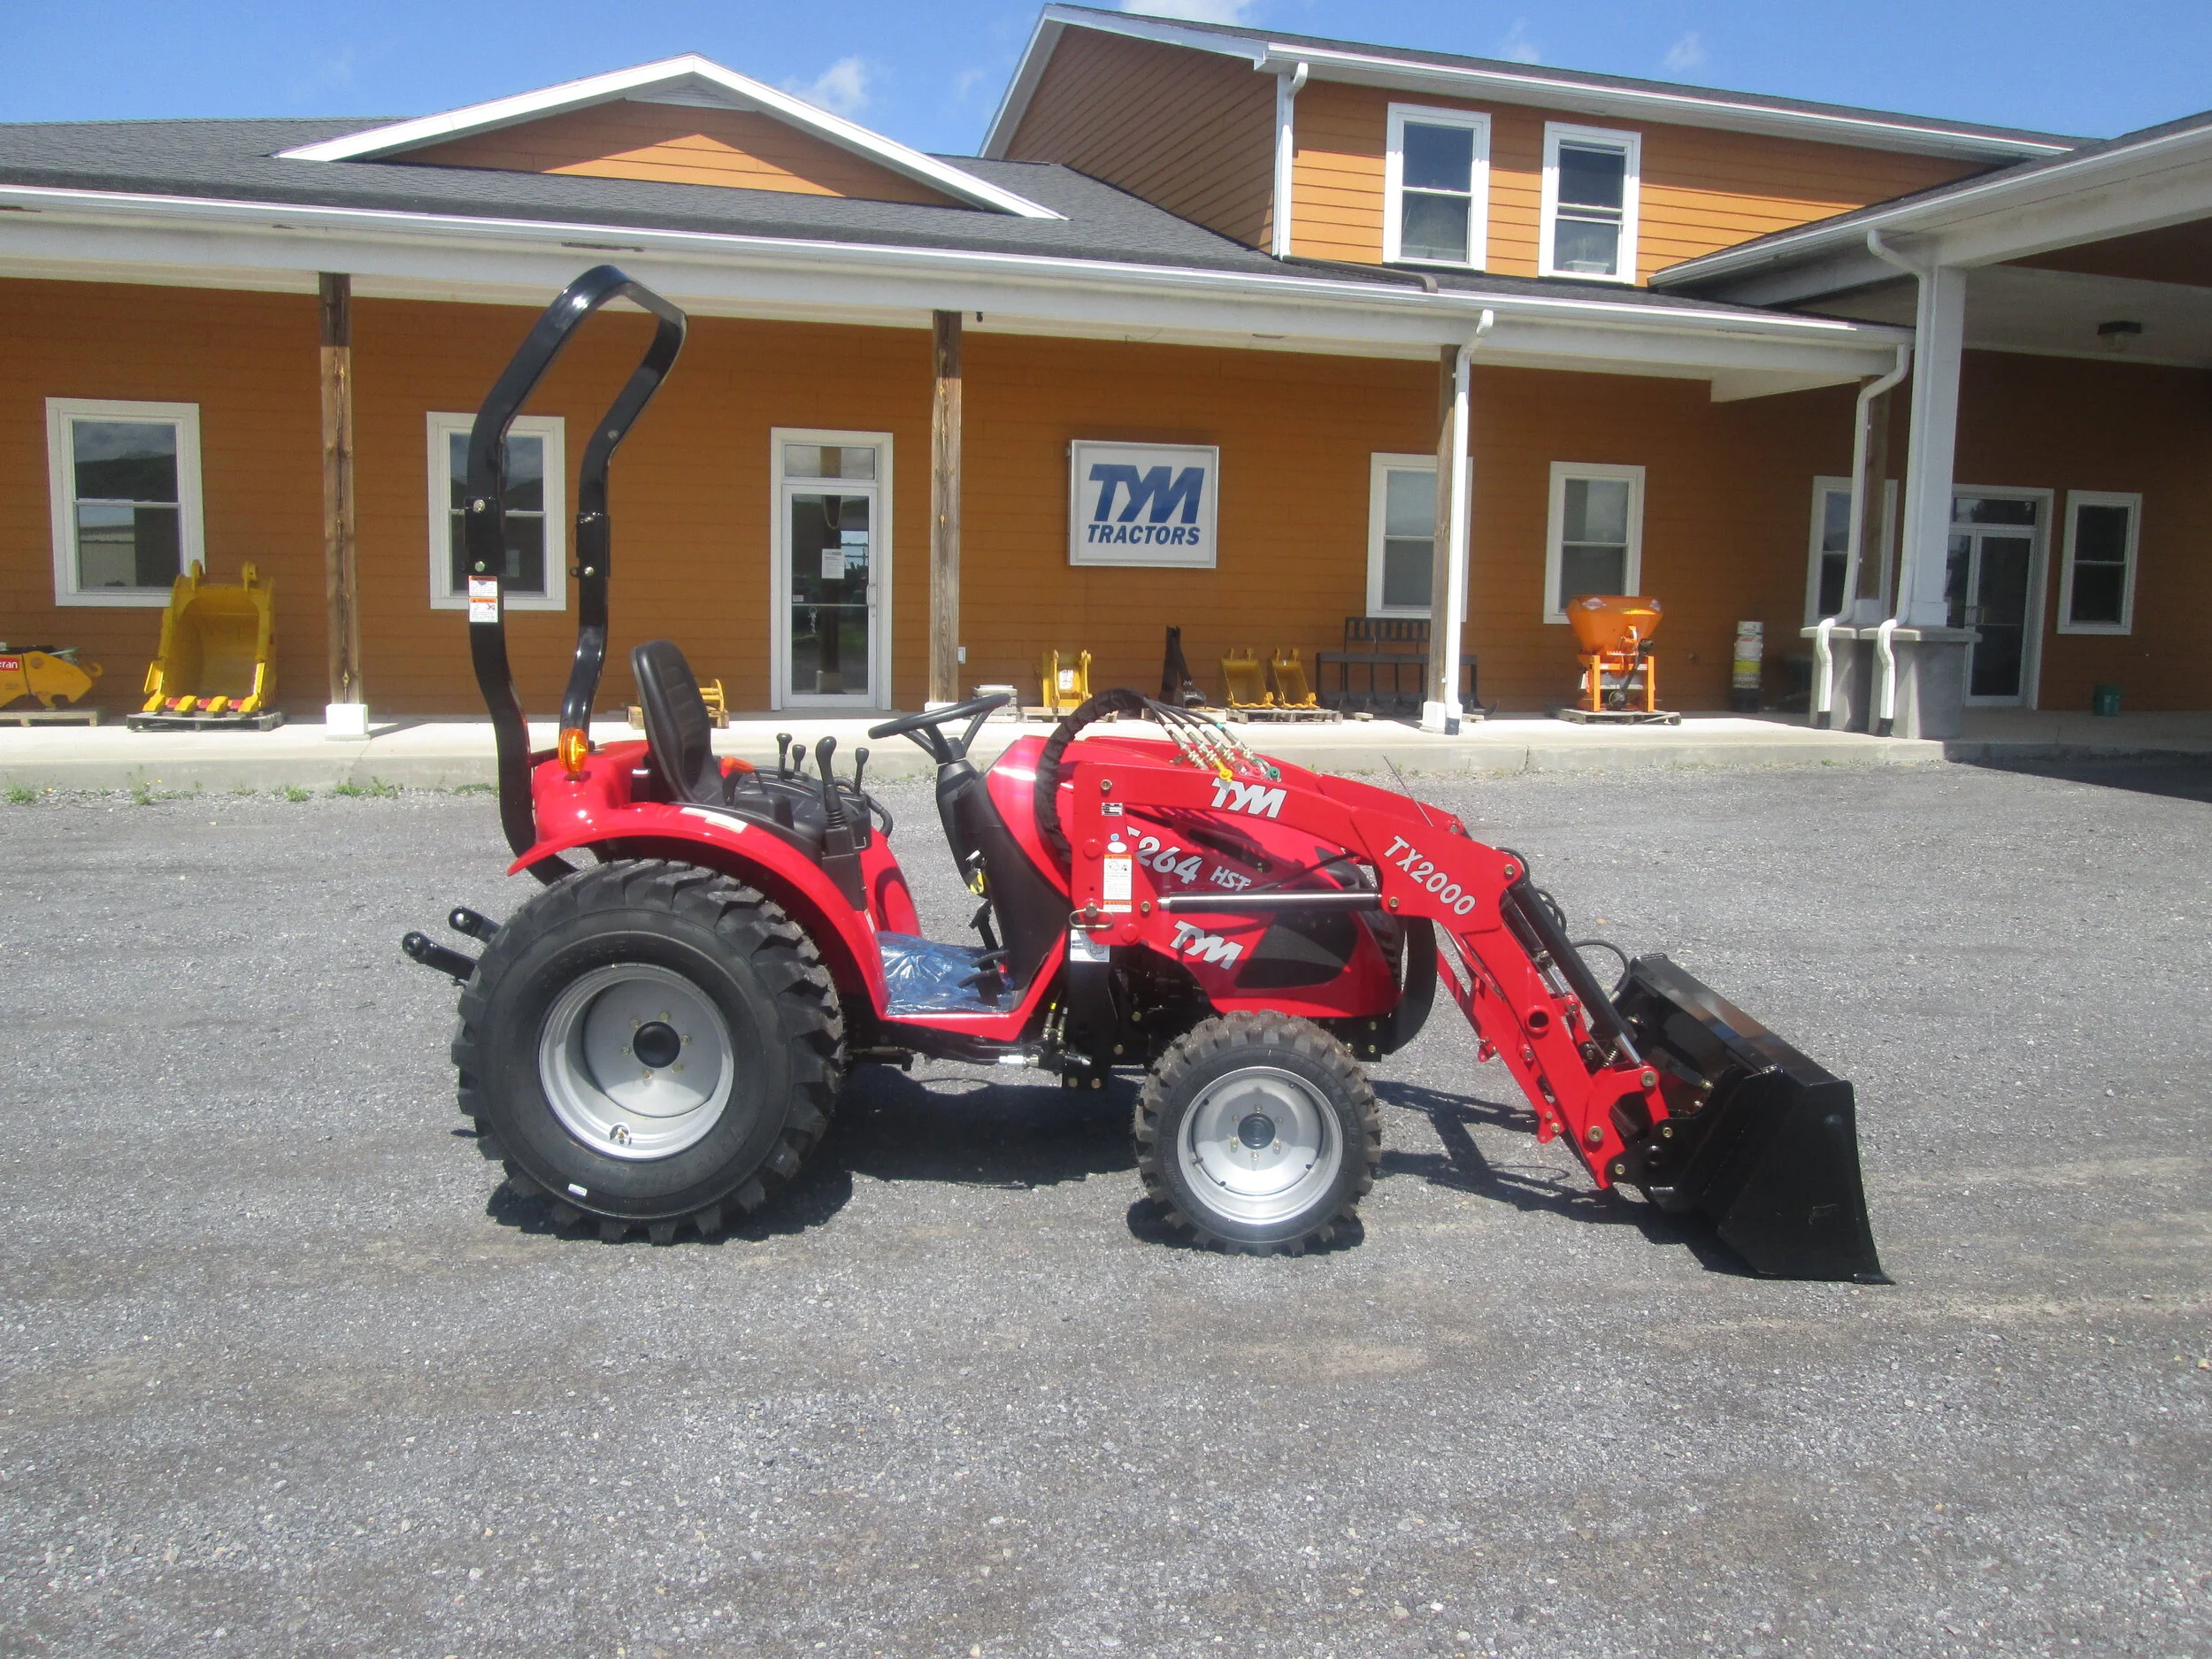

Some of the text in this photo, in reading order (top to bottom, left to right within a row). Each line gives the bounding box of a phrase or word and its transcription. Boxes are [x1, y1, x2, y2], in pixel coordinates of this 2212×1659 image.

[1088, 464, 1205, 524] TYM
[1087, 524, 1201, 546] TRACTORS
[1210, 777, 1287, 818] TYM
[1210, 865, 1253, 892] HST
[1383, 834, 1476, 915] TX2000
[1169, 920, 1244, 970] TYM
